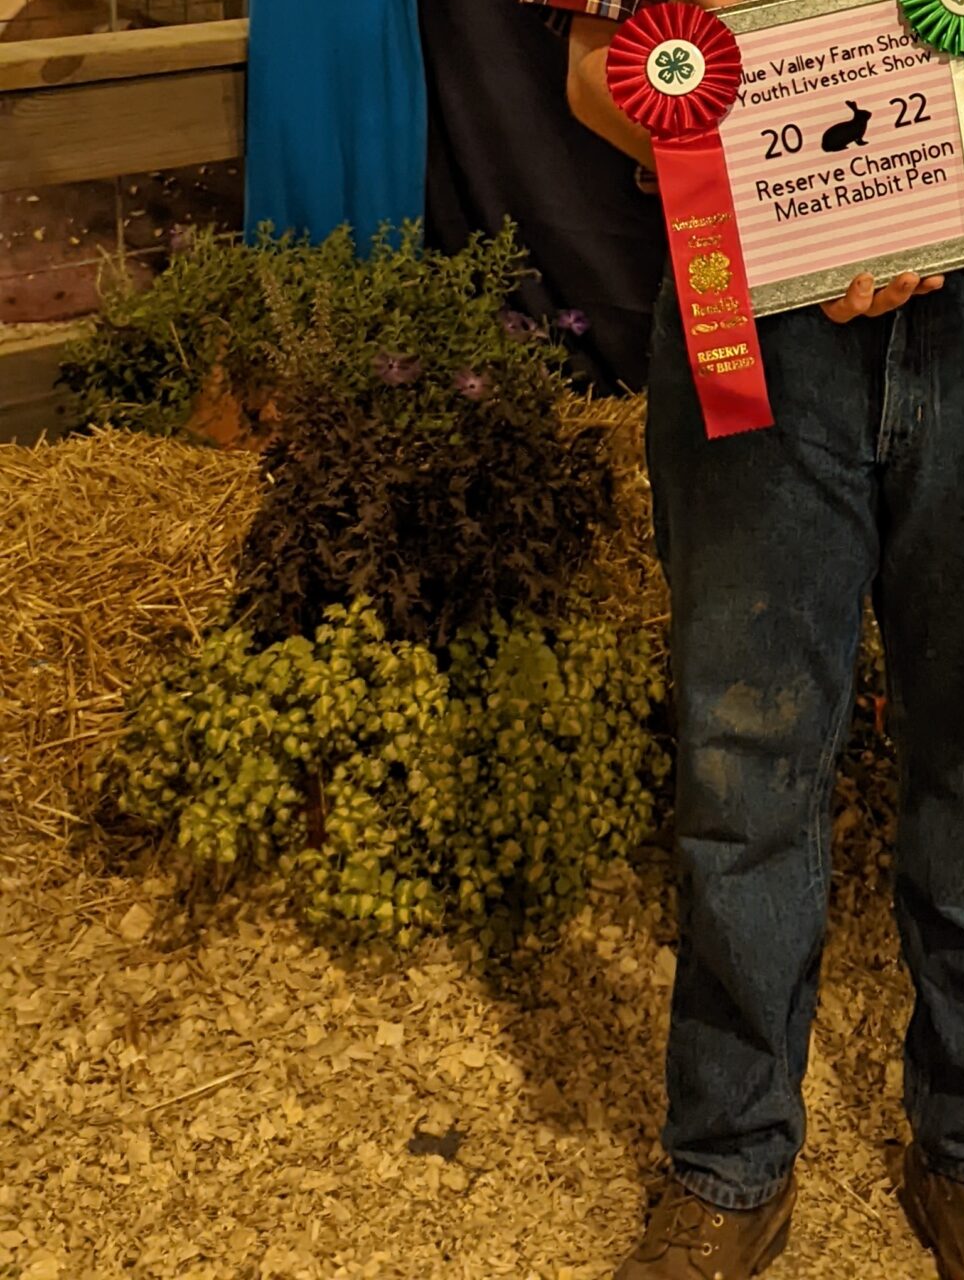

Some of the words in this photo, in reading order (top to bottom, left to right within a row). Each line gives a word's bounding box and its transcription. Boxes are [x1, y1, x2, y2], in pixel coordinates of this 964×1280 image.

[736, 81, 790, 107] Youth
[791, 61, 878, 95] Livestock
[882, 50, 931, 72] Show
[740, 68, 766, 85] lue
[769, 54, 826, 77] Valley
[829, 42, 875, 64] Farm
[760, 124, 803, 160] 20
[889, 93, 931, 128] 22
[755, 169, 845, 201] Reserve
[850, 141, 954, 176] Champion
[774, 193, 832, 222] Meat
[834, 173, 903, 207] Rabbit
[906, 168, 947, 189] Pen
[697, 343, 749, 363] RESERVE
